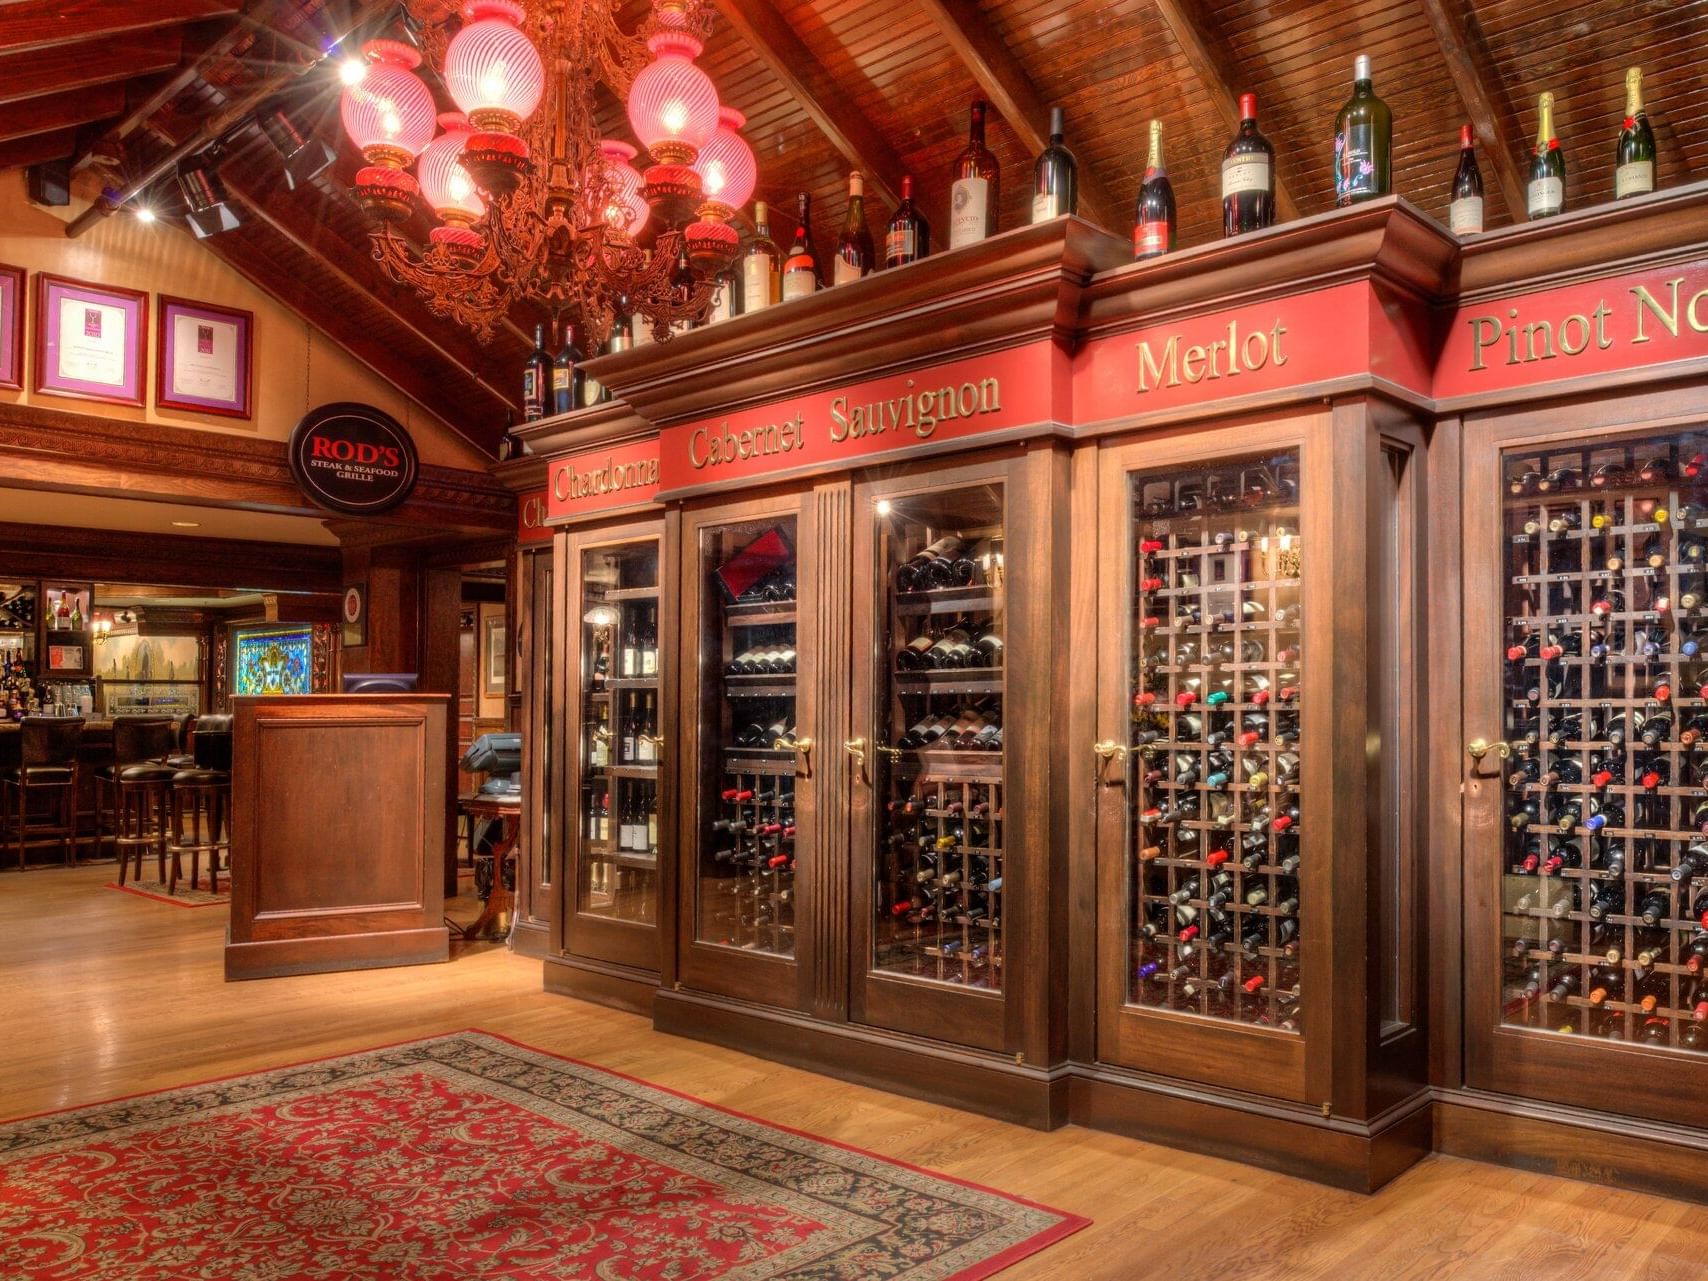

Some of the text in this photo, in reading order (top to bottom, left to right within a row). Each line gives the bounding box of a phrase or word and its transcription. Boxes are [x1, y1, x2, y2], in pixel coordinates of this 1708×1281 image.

[1136, 318, 1288, 393] Merlot
[1468, 299, 1613, 371] Pinot
[688, 377, 1001, 469] Cabernet Sauvignon
[311, 459, 399, 478] STEAK & SEAFOOD
[312, 436, 400, 467] ROD'S
[336, 470, 375, 482] GRILLE
